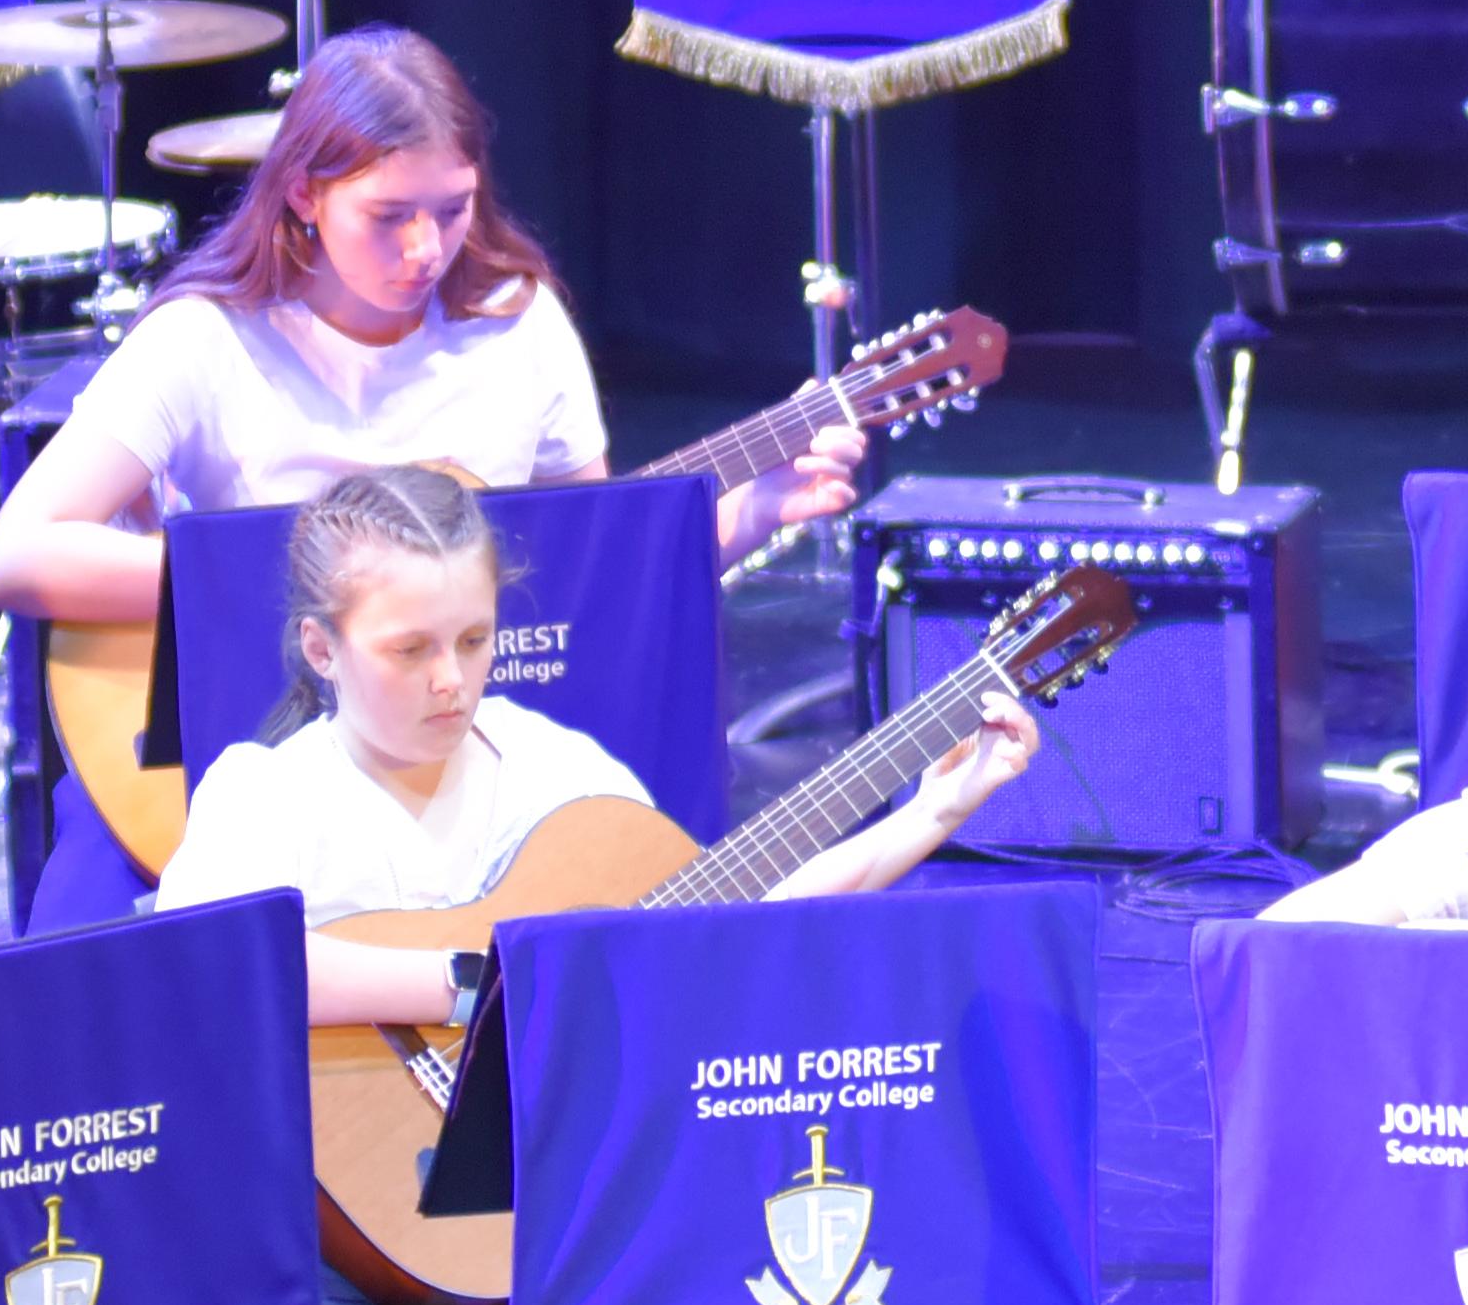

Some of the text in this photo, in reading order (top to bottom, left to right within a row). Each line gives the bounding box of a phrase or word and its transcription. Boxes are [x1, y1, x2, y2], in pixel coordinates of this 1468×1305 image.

[492, 623, 569, 657] REST
[485, 659, 565, 683] ollege
[690, 1042, 942, 1091] JOHN FORREST
[696, 1081, 935, 1119] Secondary College
[35, 1103, 164, 1152] FORREST
[71, 1146, 157, 1175] College
[784, 1195, 857, 1280] JF
